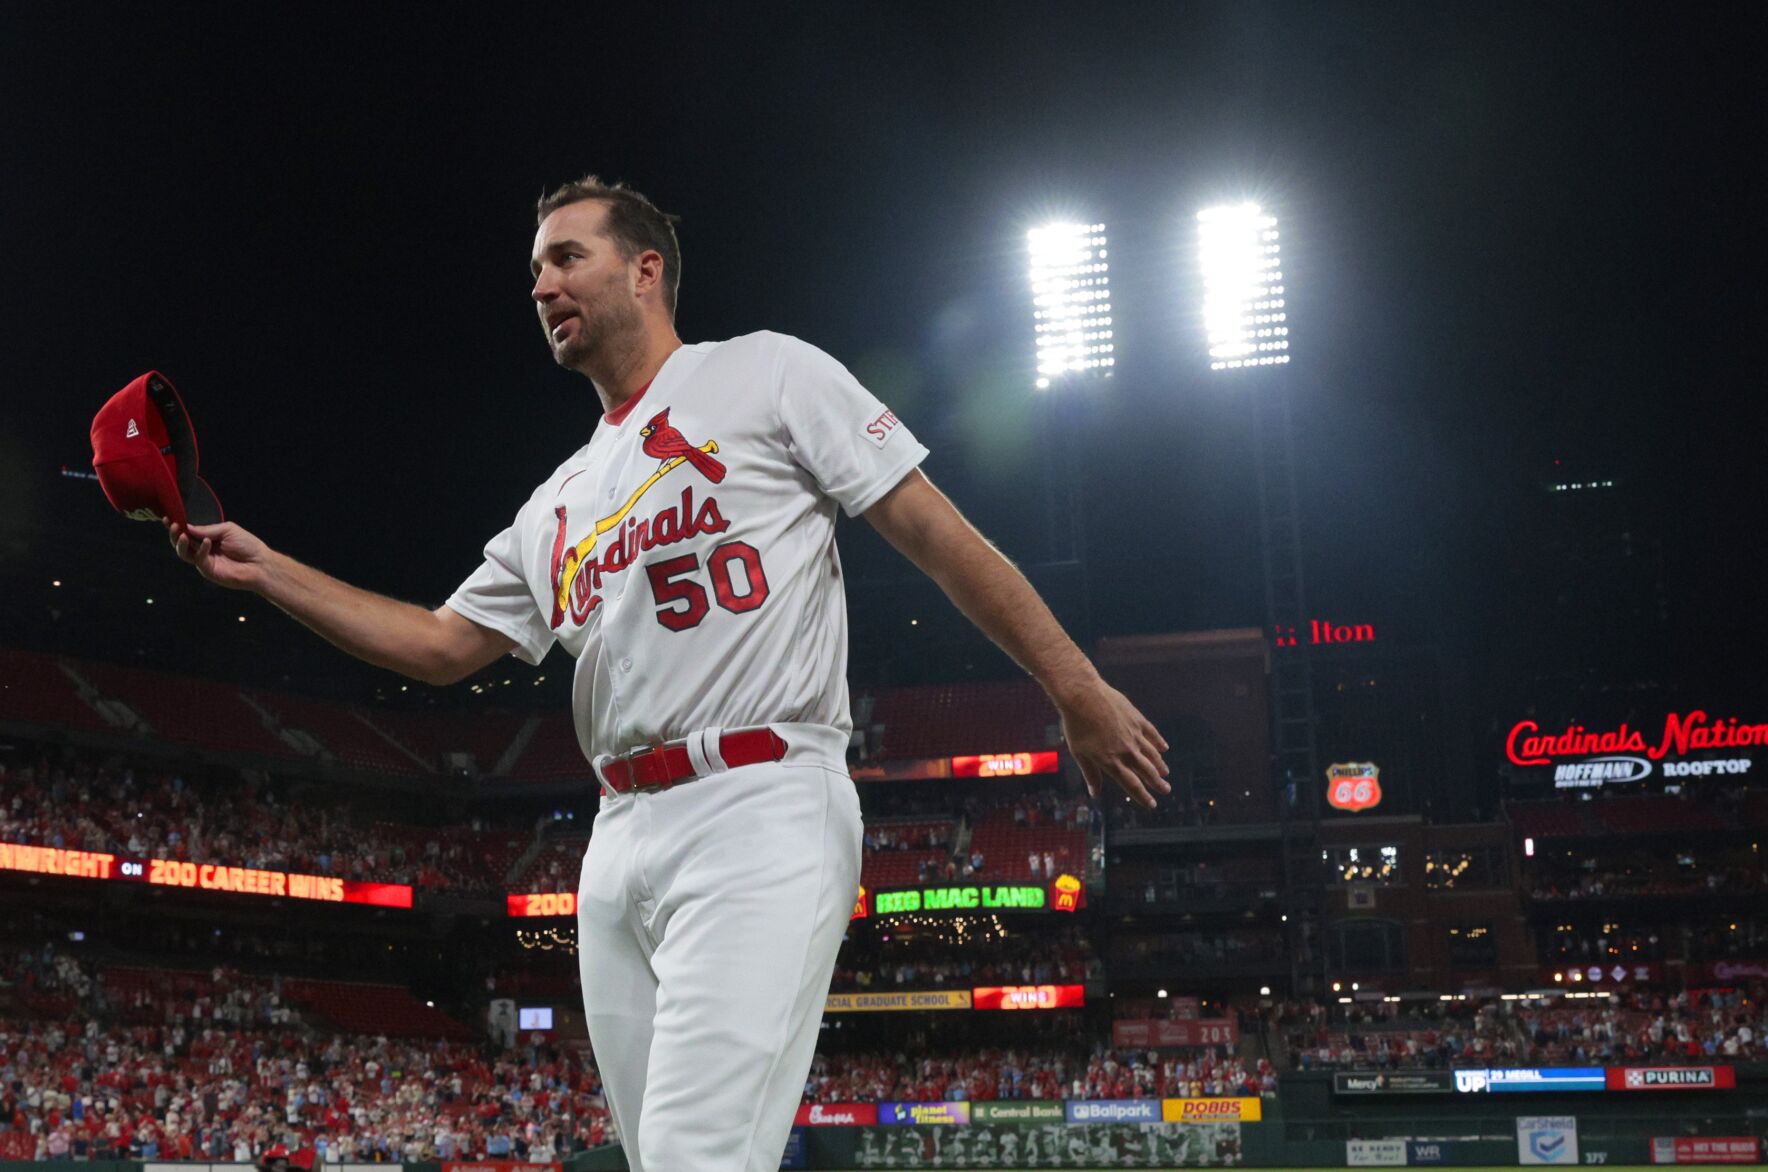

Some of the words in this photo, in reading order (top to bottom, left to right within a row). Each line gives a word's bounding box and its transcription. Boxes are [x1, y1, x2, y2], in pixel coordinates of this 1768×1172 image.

[645, 540, 770, 633] 50
[1506, 720, 1646, 766] Cardinals
[1647, 709, 1768, 760] Nation
[1555, 761, 1635, 781] HOFFMANN
[1663, 759, 1751, 777] ROOFTOP
[1335, 781, 1371, 803] 66
[121, 862, 142, 876] ON
[150, 859, 197, 887] 200
[200, 864, 286, 896] CAREER
[288, 873, 344, 901] WINS
[527, 893, 575, 916] 200
[876, 890, 920, 913] BIG
[924, 887, 979, 910] MAC
[982, 887, 1044, 908] LAND
[856, 994, 908, 1007] GRADUATE
[911, 994, 950, 1006] SCHOOL
[1347, 1079, 1378, 1091] Mercy
[1456, 1076, 1486, 1092] UP
[1646, 1071, 1710, 1084] PURINA
[990, 1106, 1031, 1118] Central
[1033, 1106, 1062, 1117] Bank
[1090, 1104, 1151, 1119] Ballpark
[1183, 1101, 1241, 1114] DOBBS
